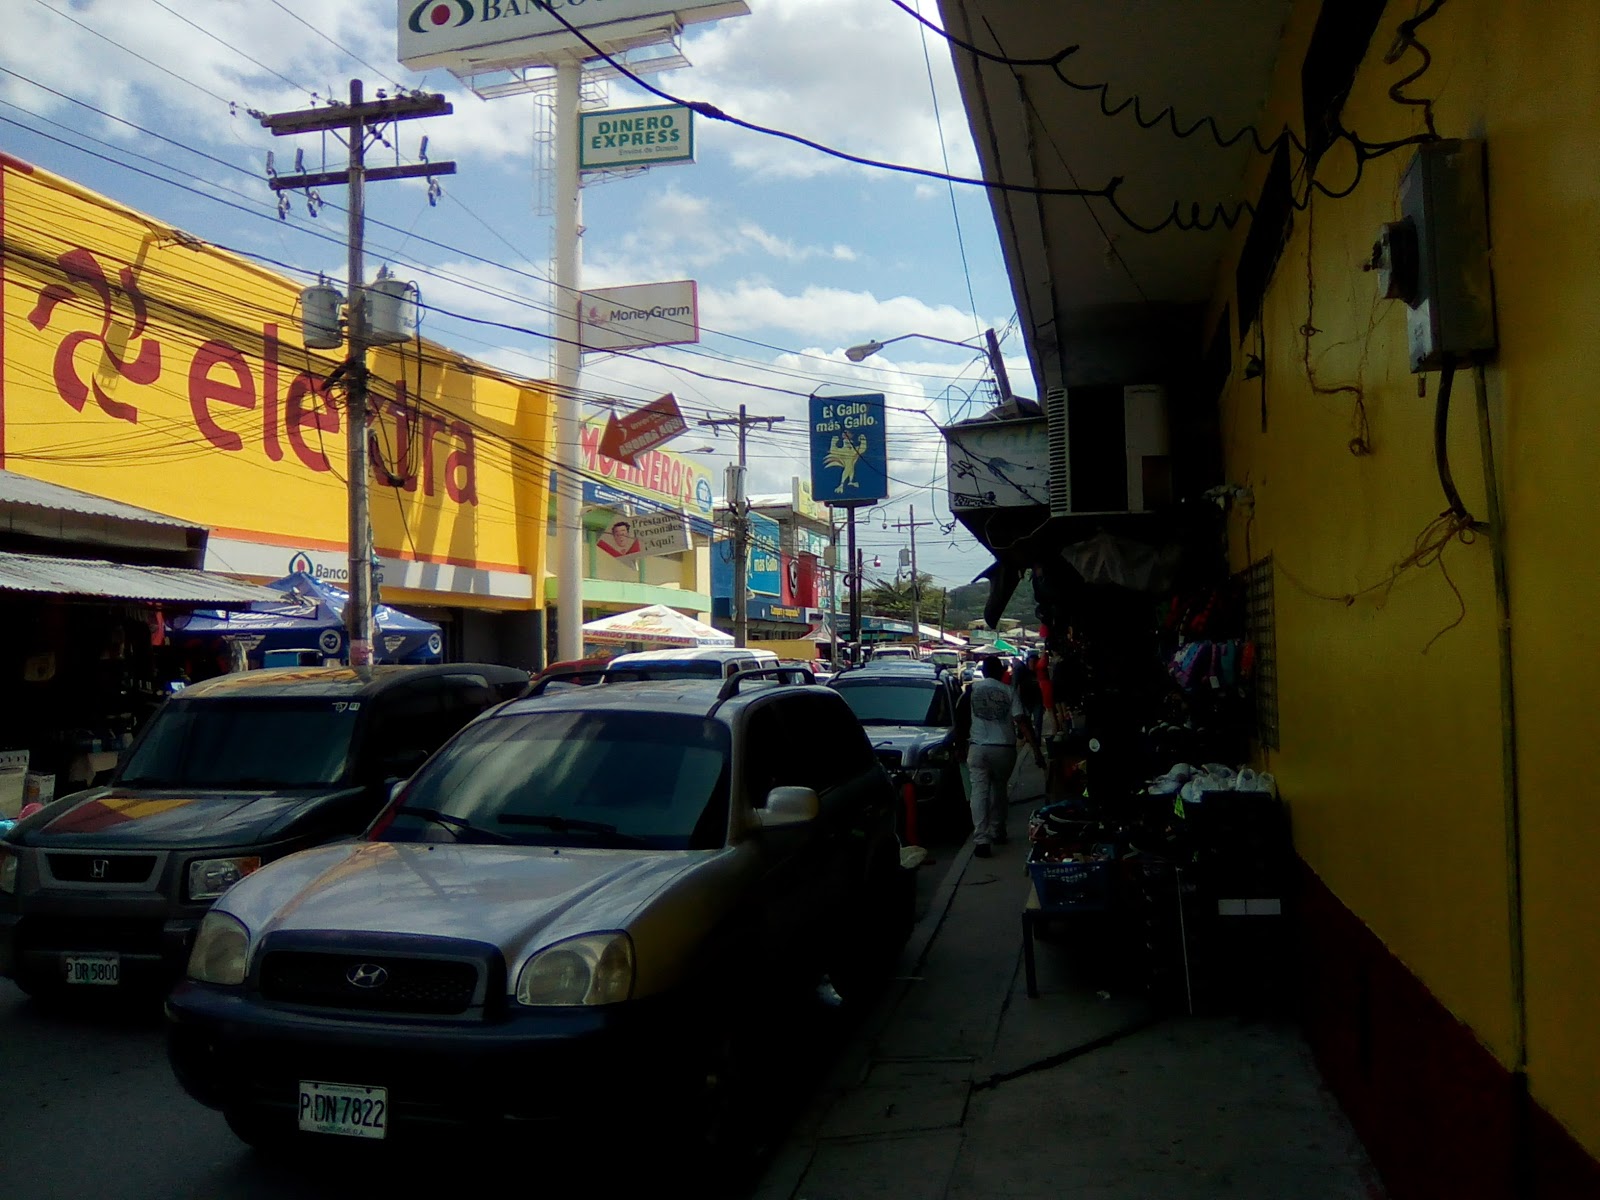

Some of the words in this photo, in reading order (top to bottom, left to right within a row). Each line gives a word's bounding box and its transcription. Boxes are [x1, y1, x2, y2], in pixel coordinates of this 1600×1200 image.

[479, 0, 586, 22] BAN
[598, 115, 674, 134] DINERO
[591, 129, 680, 149] EXPRESS
[609, 305, 691, 322] MoneyGram
[822, 404, 834, 419] El
[836, 402, 867, 417] Gallo
[816, 419, 841, 433] más
[843, 413, 875, 429] Gallo
[315, 563, 348, 580] Banco
[591, 630, 623, 639] AMIGO
[626, 632, 639, 640] DE
[641, 633, 654, 641] SU
[656, 634, 691, 645] HOGAR
[340, 1096, 385, 1128] 7822
